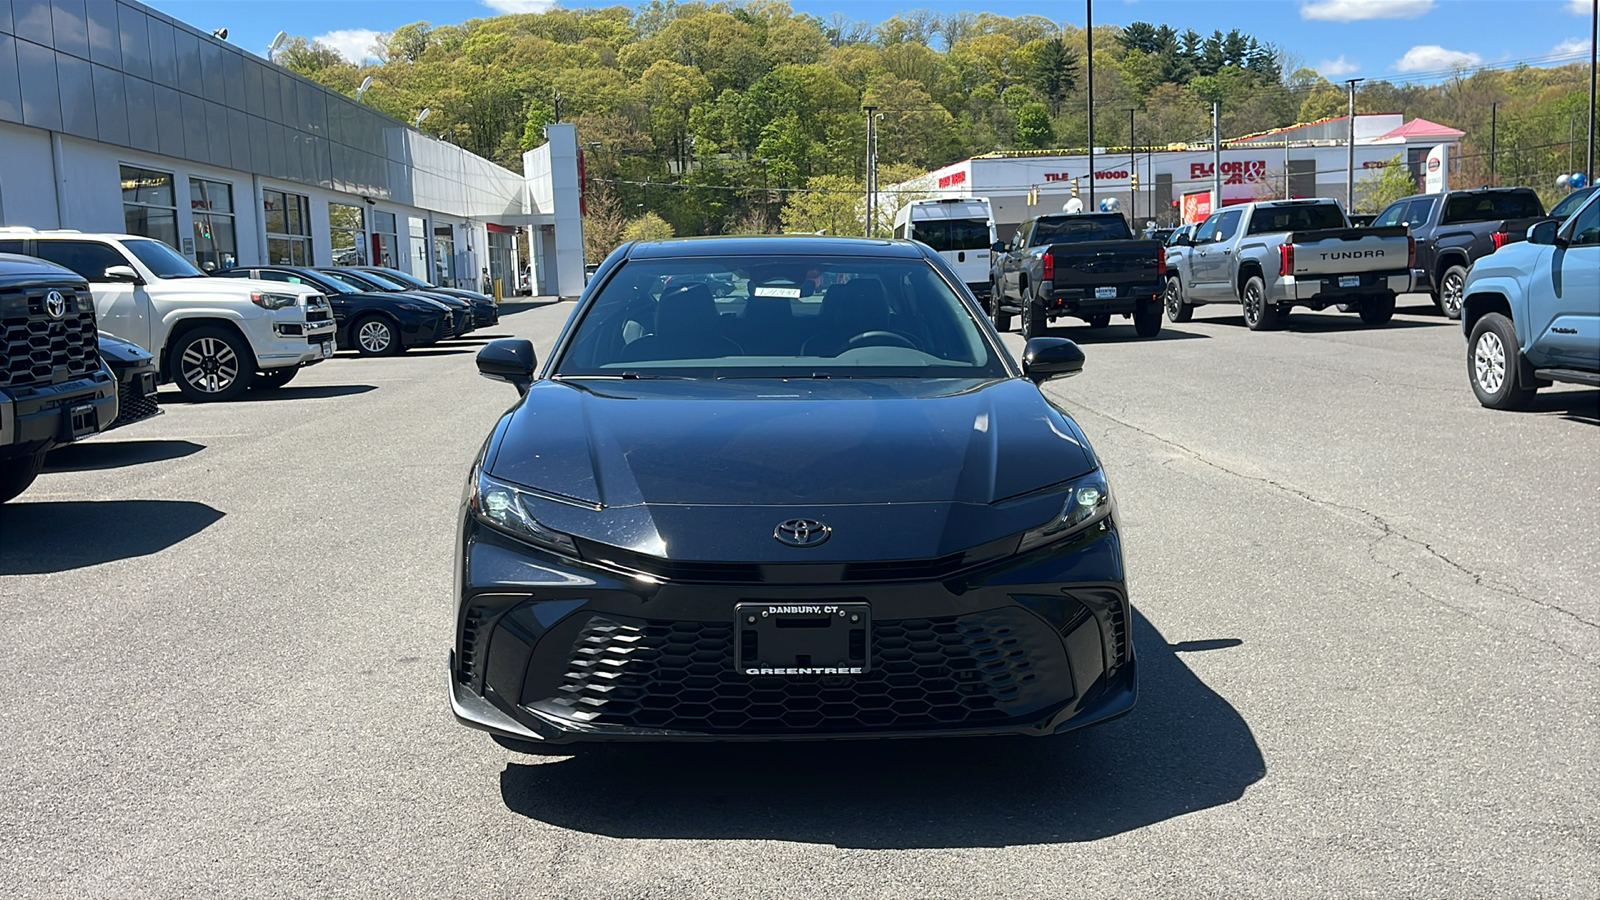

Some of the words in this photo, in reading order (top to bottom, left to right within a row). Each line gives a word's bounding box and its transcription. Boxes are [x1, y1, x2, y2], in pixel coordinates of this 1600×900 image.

[1190, 162, 1243, 175] FLOOR
[1044, 173, 1069, 182] TILE
[1094, 171, 1129, 180] WOOD
[1320, 249, 1385, 261] TUNDRA
[768, 606, 822, 615] DANBURY,
[824, 605, 839, 614] CT
[745, 667, 862, 675] GREENTREE
